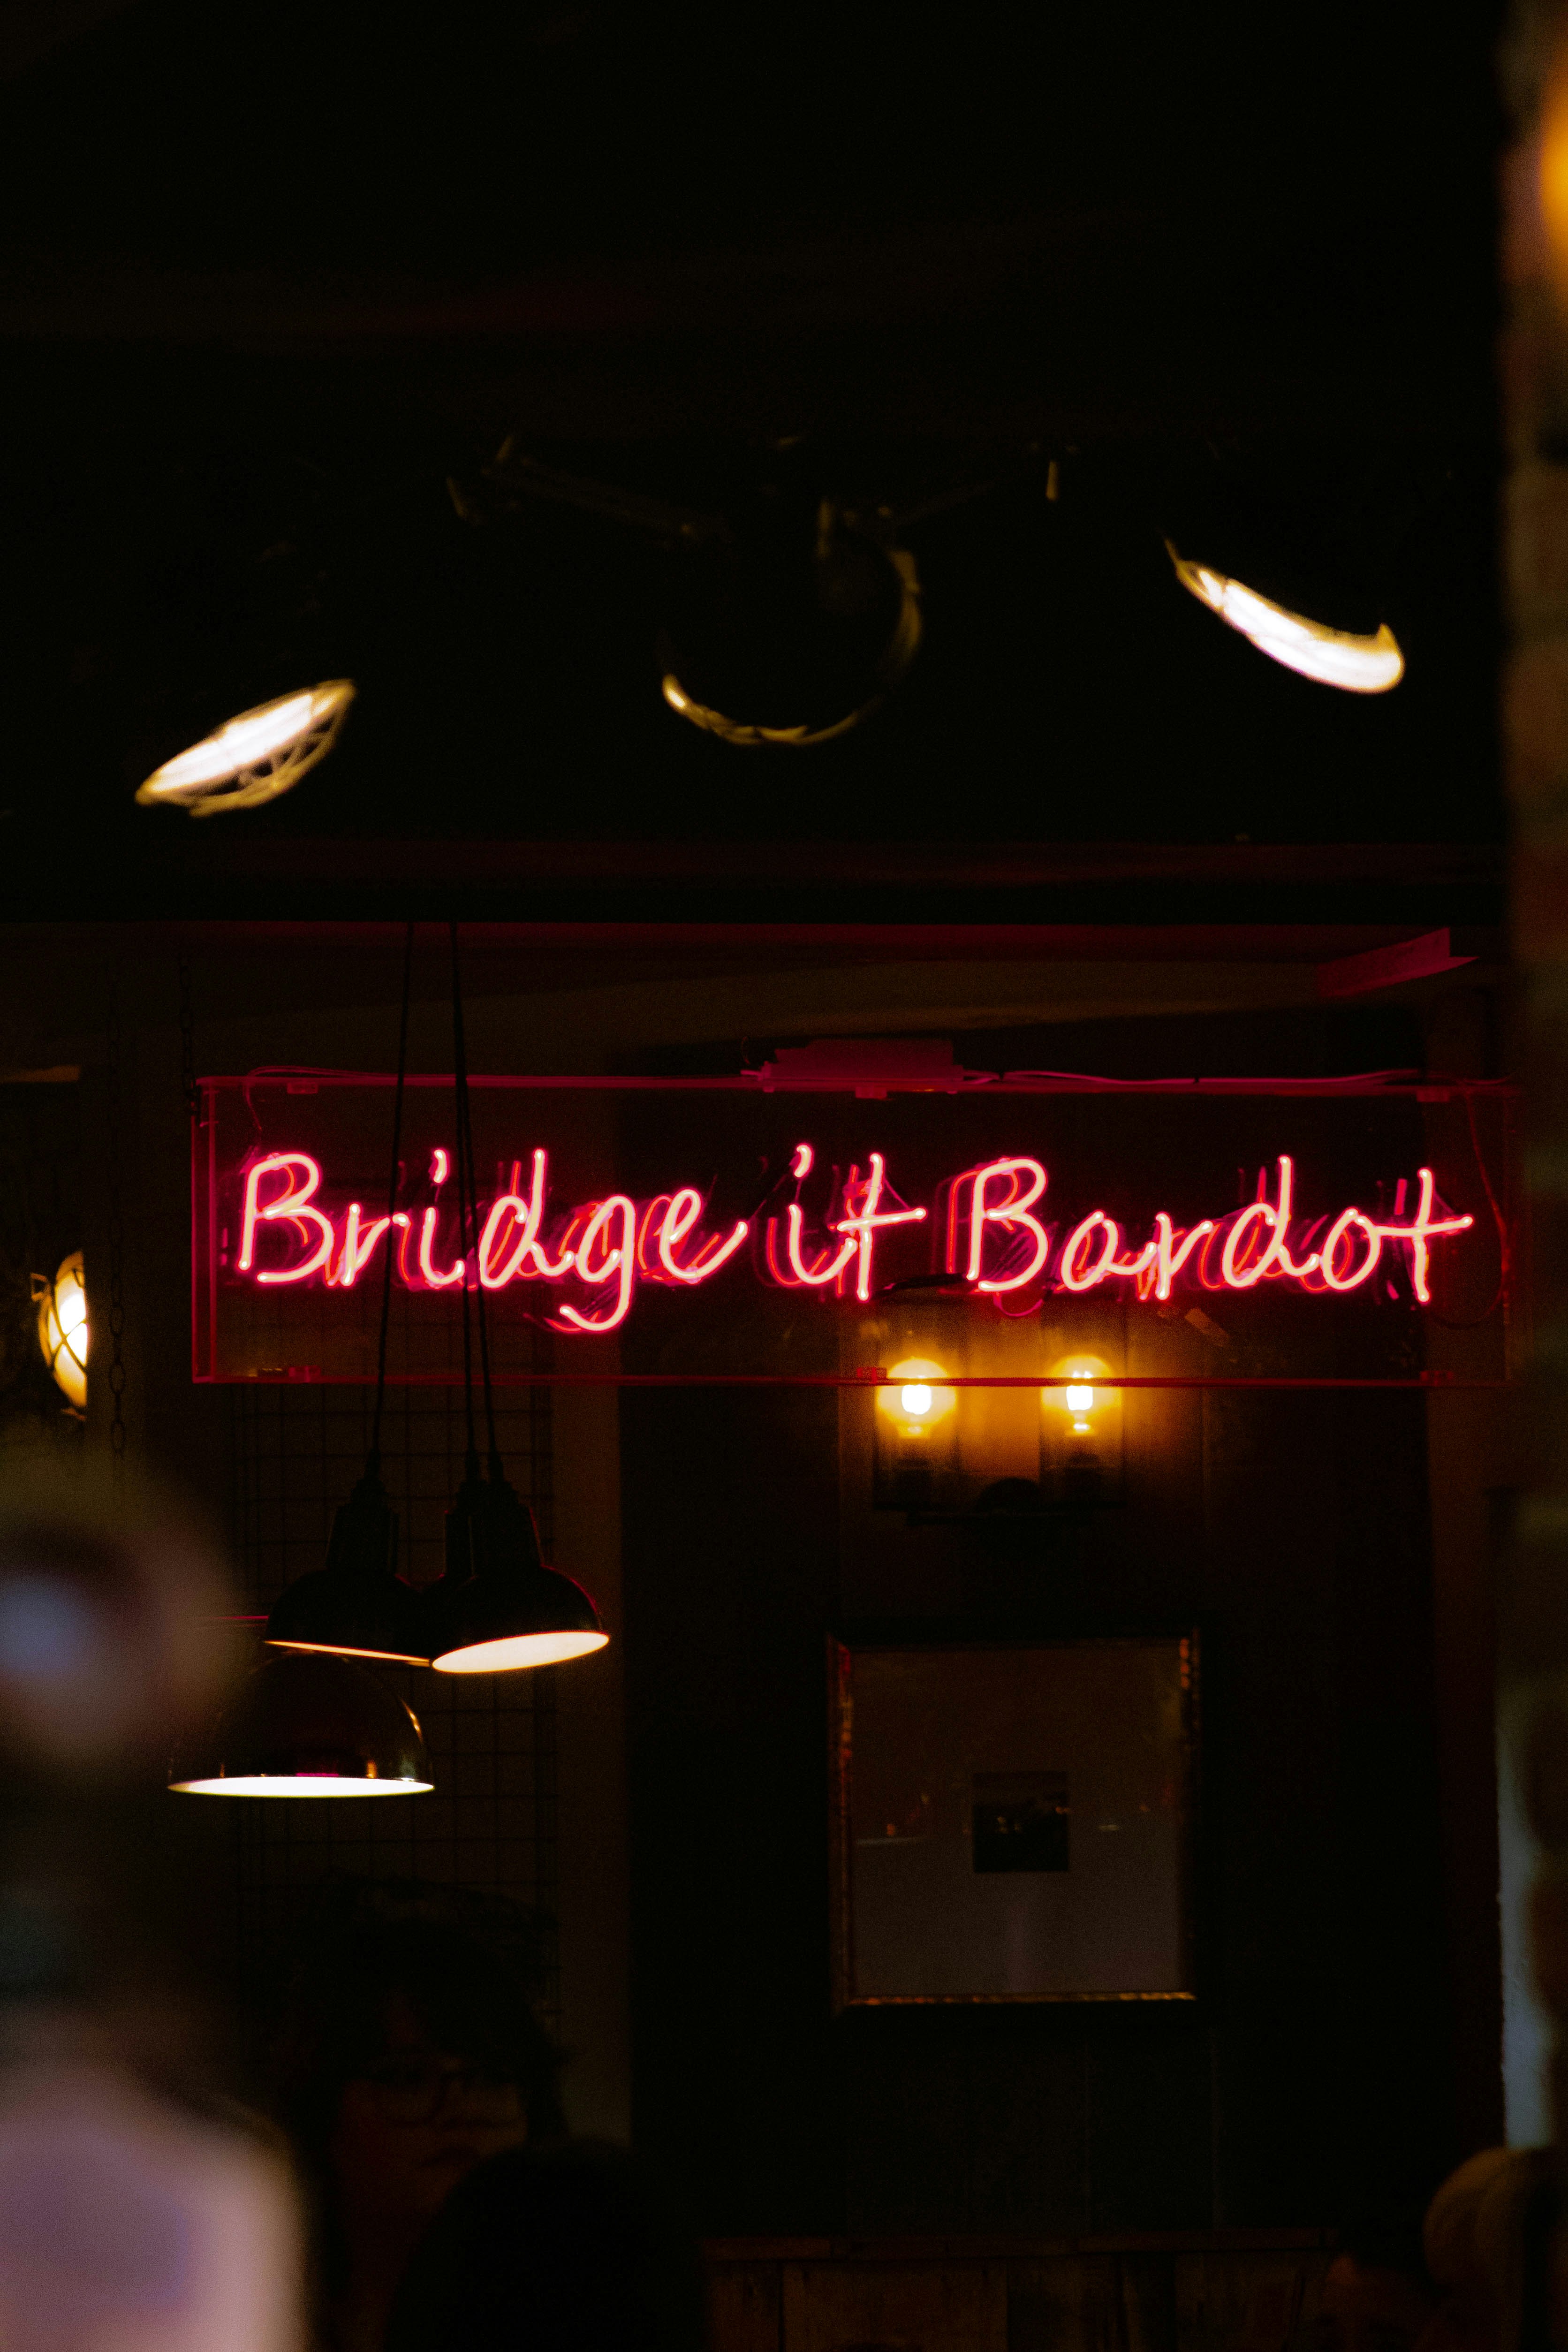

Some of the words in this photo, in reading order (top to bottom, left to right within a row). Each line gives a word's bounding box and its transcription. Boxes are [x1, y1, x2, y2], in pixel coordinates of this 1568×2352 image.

[237, 1147, 749, 1333] Bridge
[787, 1143, 928, 1302] it
[964, 1154, 1475, 1304] Bardot
